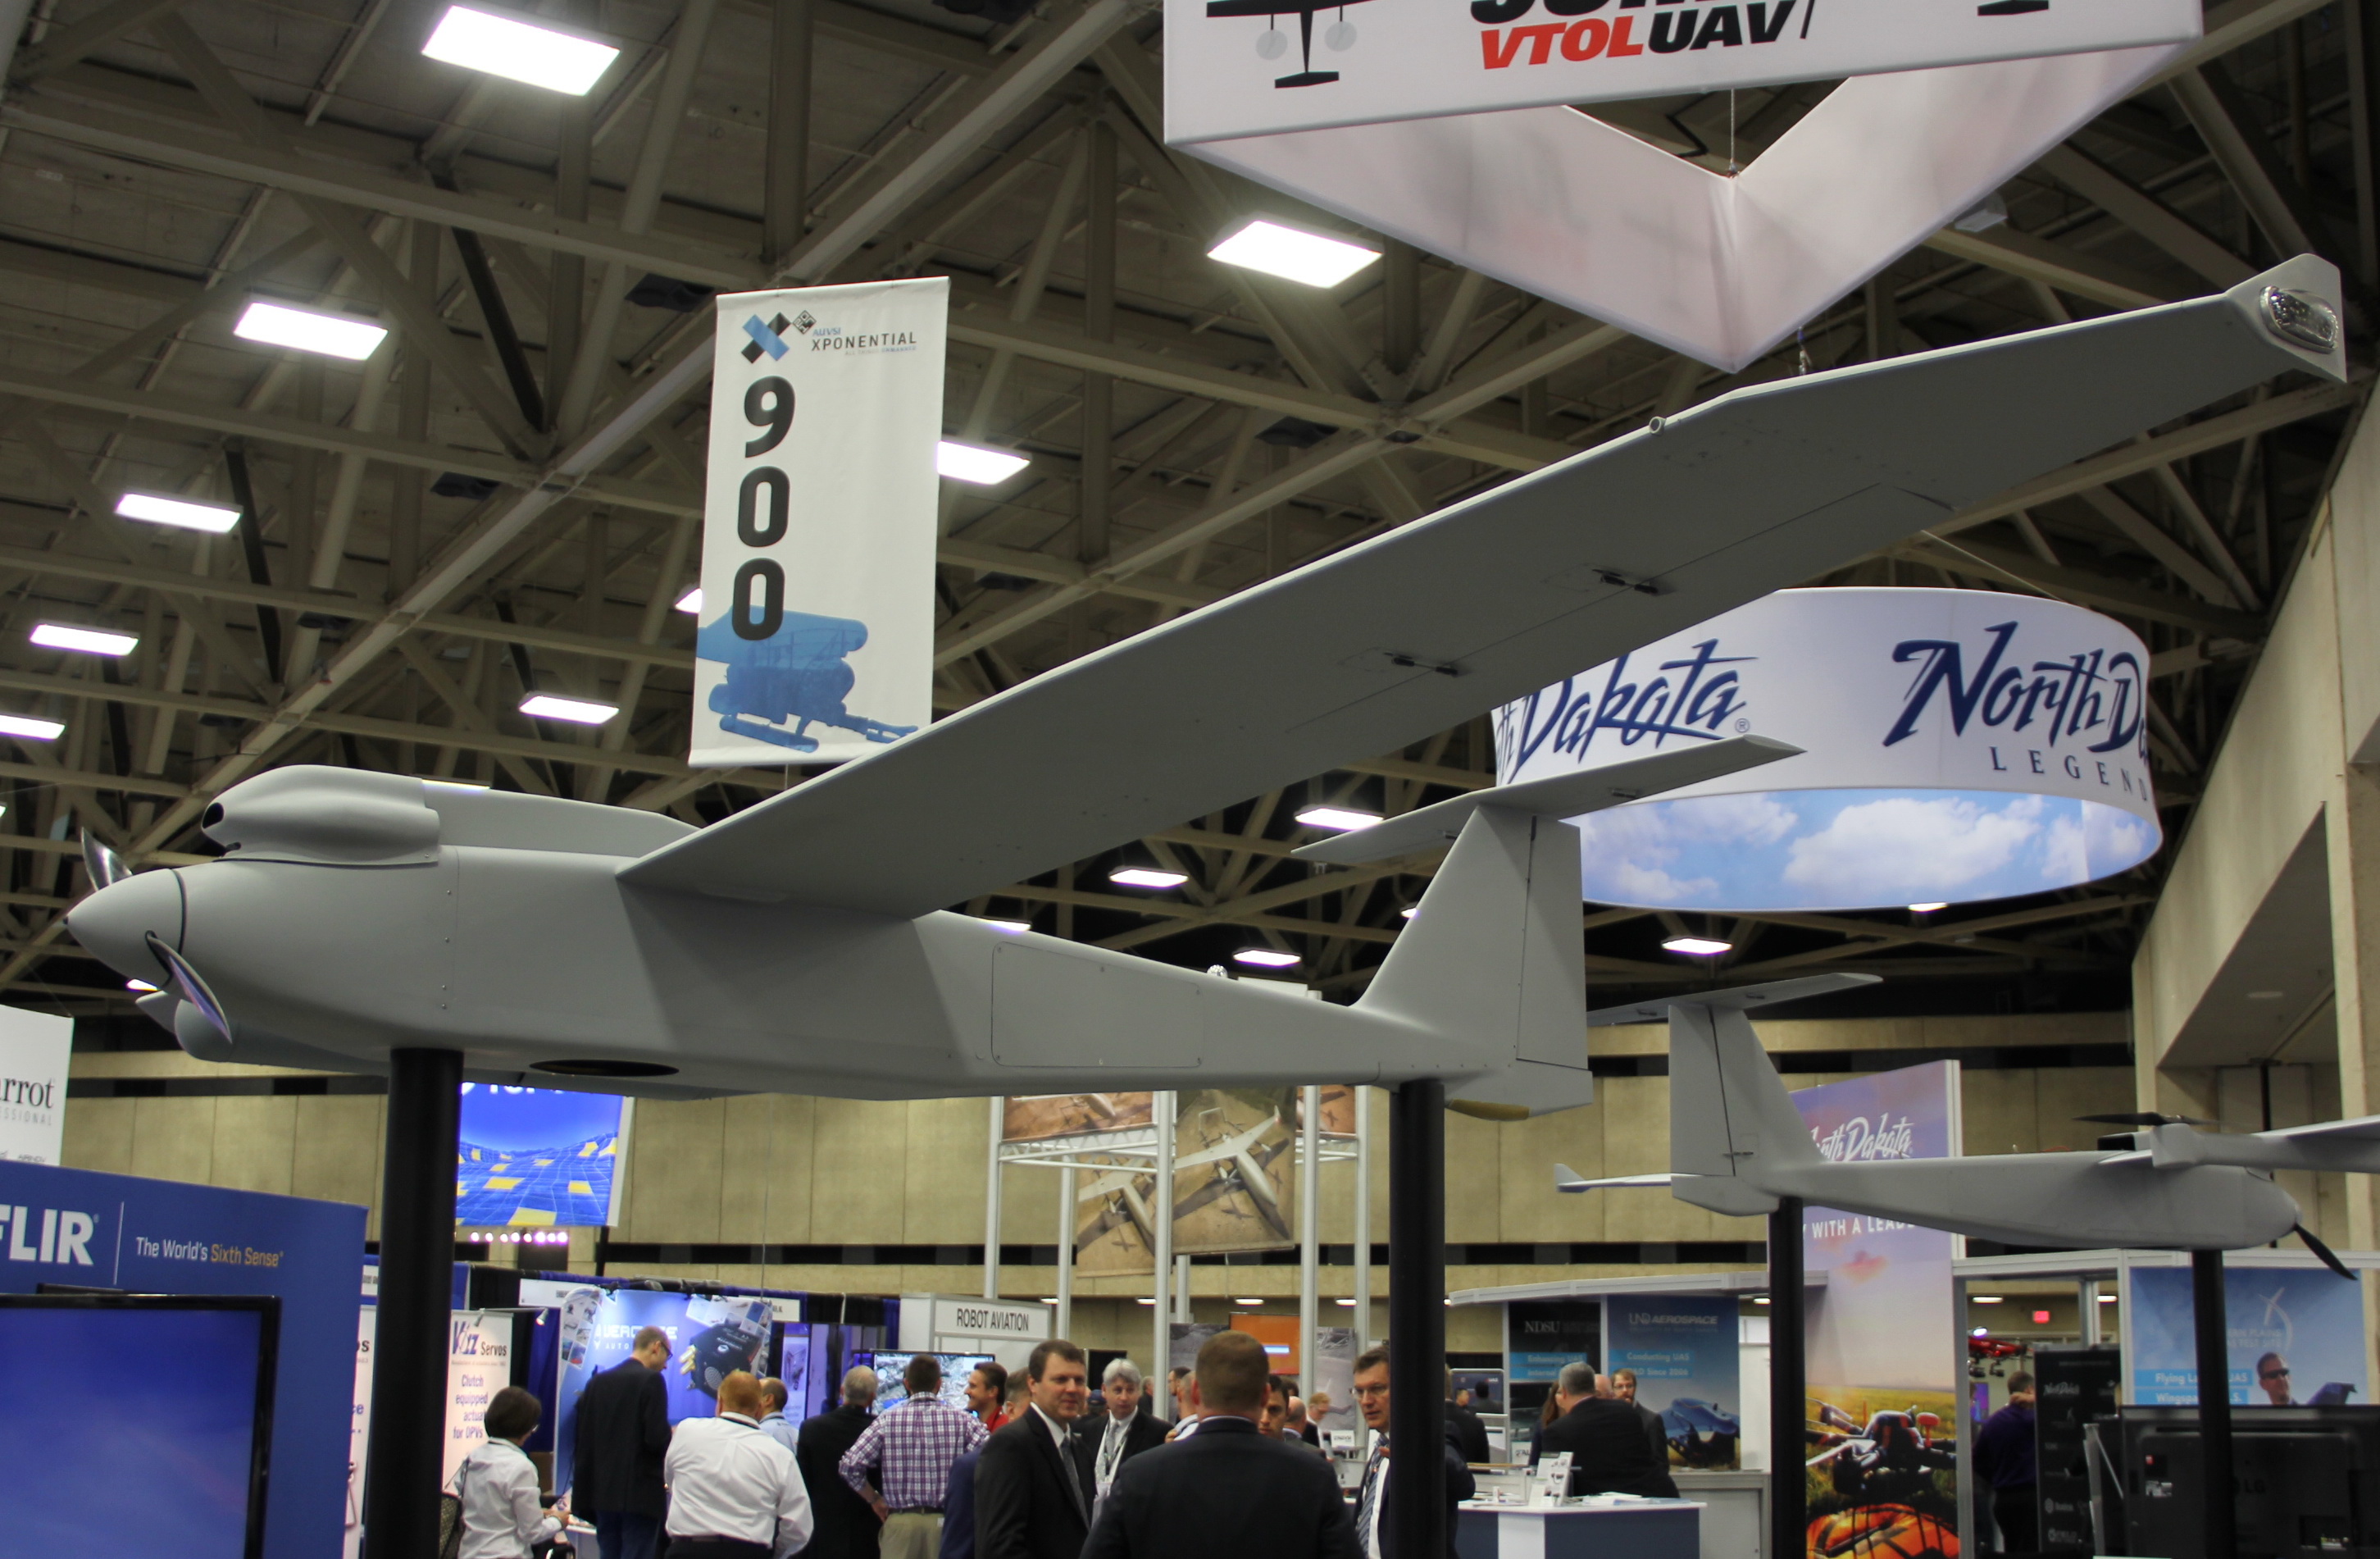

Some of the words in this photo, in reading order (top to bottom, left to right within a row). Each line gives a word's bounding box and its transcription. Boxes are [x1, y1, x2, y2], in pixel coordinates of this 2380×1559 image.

[812, 327, 841, 336] AUVSI
[812, 331, 917, 352] XPONENTIAL
[731, 375, 796, 641] 900
[1882, 621, 2108, 748] North
[1507, 638, 1759, 785] Dakota
[0, 1078, 55, 1109] rrot
[0, 1105, 52, 1127] SSIONAL
[1843, 1112, 1915, 1162] Dakota
[1812, 1219, 1846, 1239] WITH
[1852, 1217, 1862, 1234] A
[1867, 1215, 1915, 1233] LEA
[136, 1236, 160, 1257] The
[163, 1238, 208, 1262] World's
[210, 1243, 242, 1265] Sixth
[244, 1247, 280, 1268] Sense
[957, 1307, 989, 1329] ROBOT
[990, 1311, 1029, 1331] AVIATION
[1524, 1320, 1560, 1333] NDSU
[1651, 1315, 1719, 1325] AEROSPACE
[480, 1341, 507, 1356] Servos
[463, 1408, 486, 1421] actua
[453, 1425, 463, 1439] for
